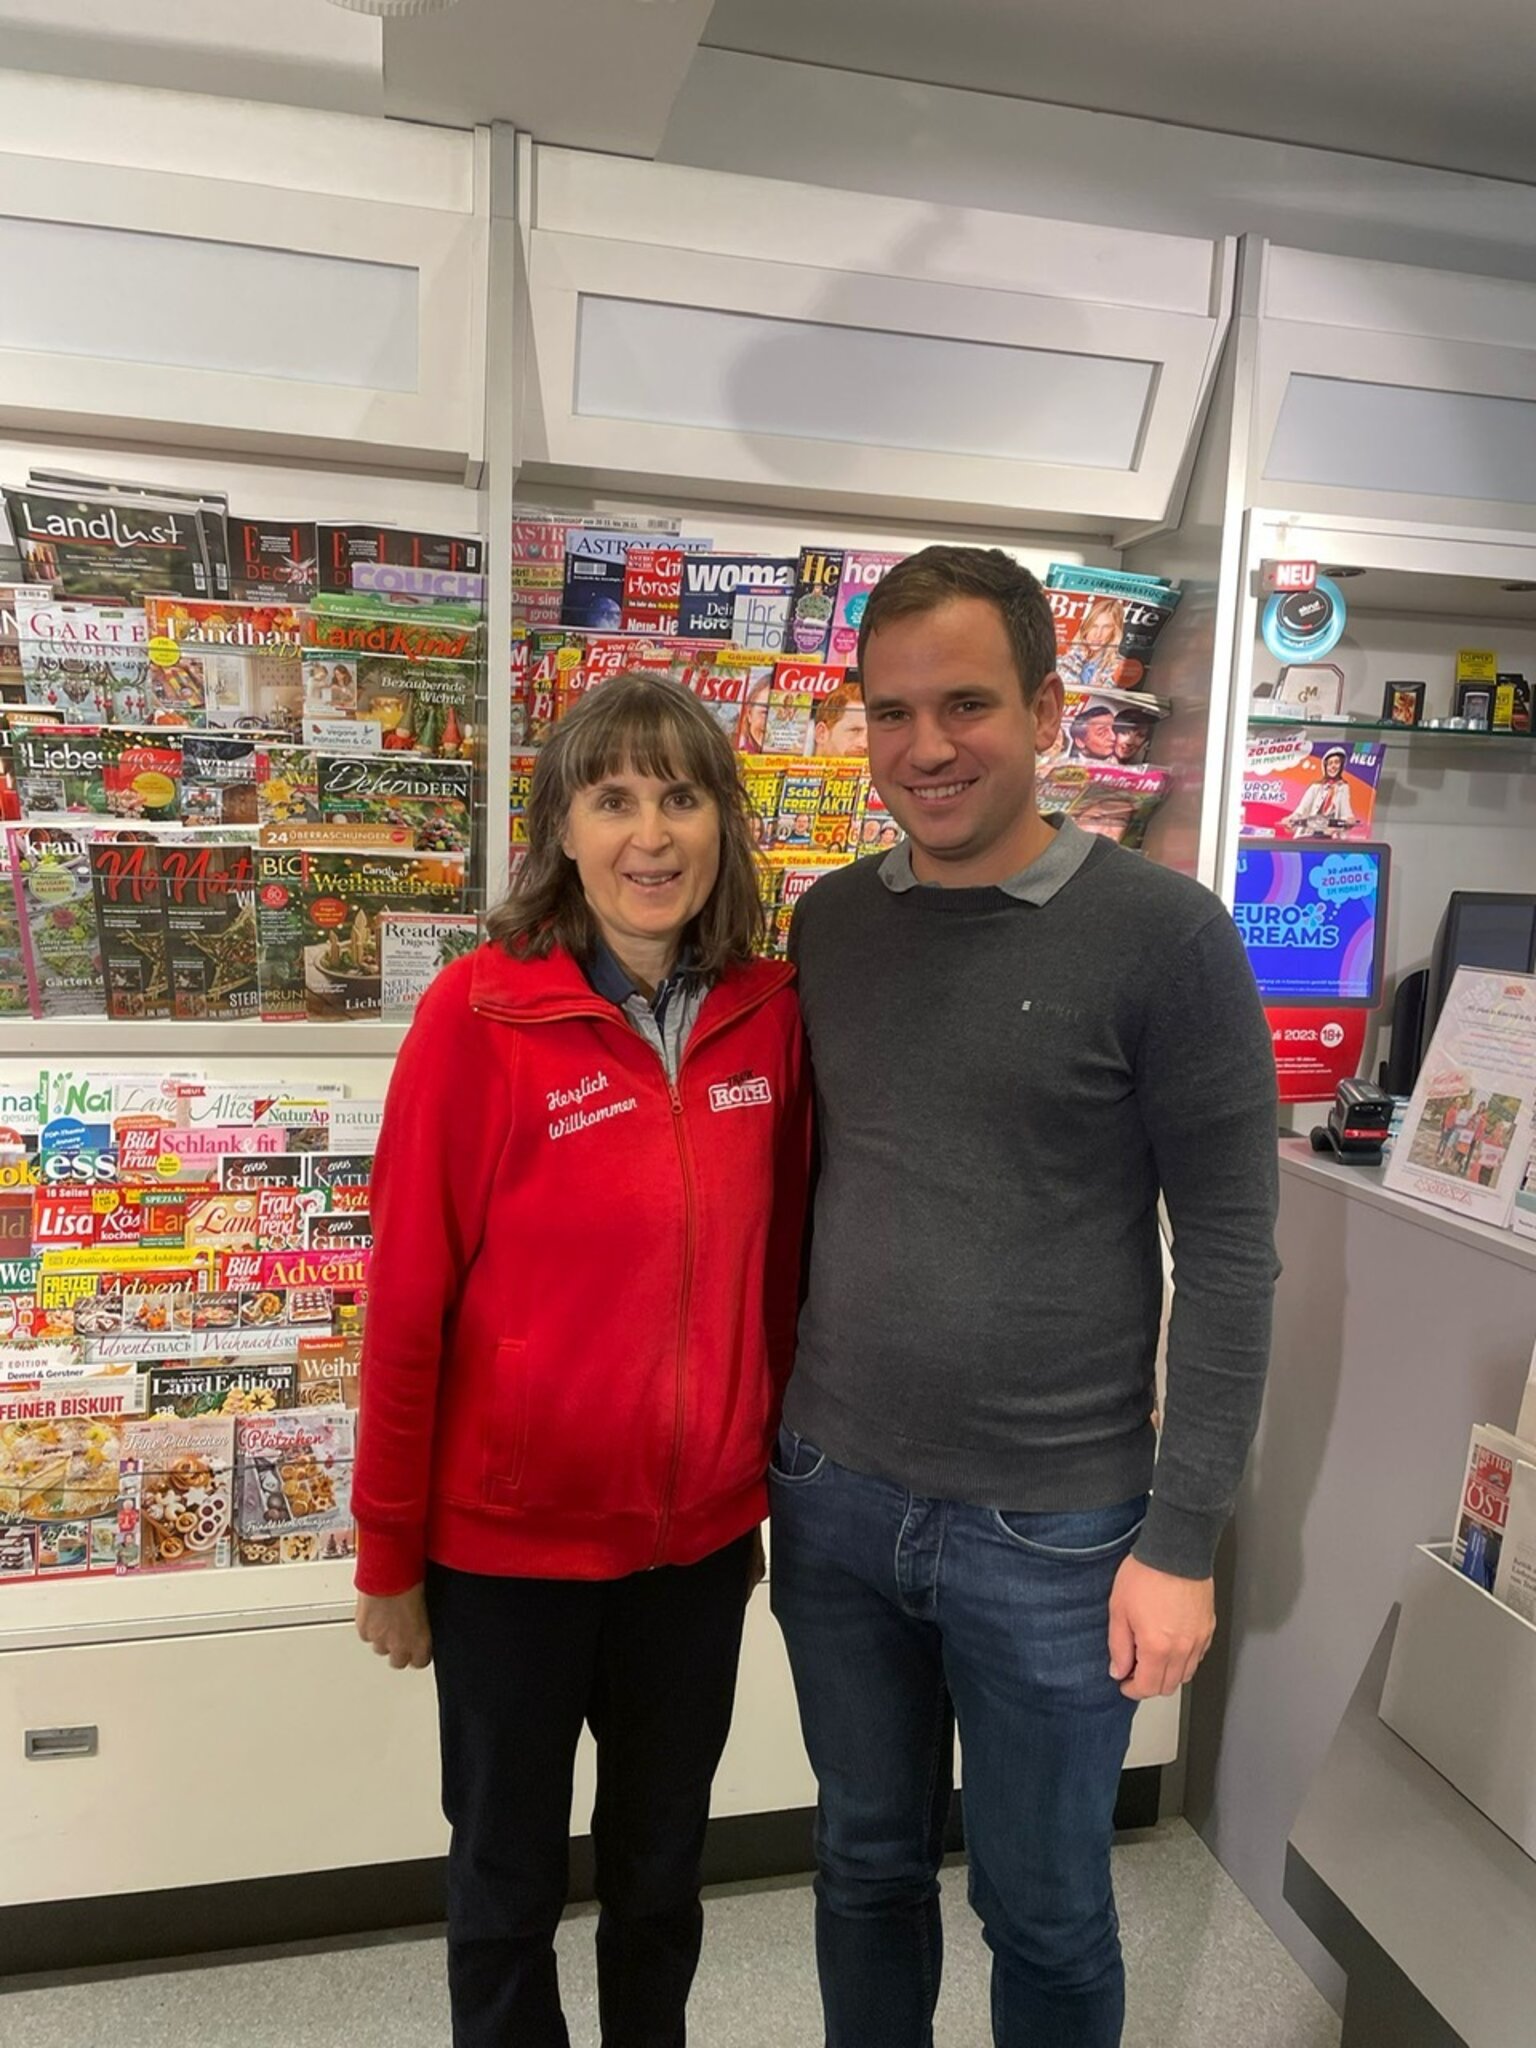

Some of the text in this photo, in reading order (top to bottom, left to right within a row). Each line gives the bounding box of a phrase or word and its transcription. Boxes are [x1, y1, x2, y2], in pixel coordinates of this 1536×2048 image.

[353, 563, 482, 598] COUCH
[801, 554, 840, 585] He
[1277, 564, 1316, 586] NEU
[778, 667, 840, 694] Gala
[1350, 752, 1377, 766] NEU
[267, 828, 391, 845] 24 ÜBERRASCHUNGEN
[313, 873, 456, 896] Weihnachten
[1234, 906, 1301, 925] EURO
[401, 938, 436, 949] Digest
[546, 1071, 609, 1111] Herzlich
[712, 1083, 768, 1107] ROTH
[548, 1097, 638, 1140] Willkommen
[125, 1130, 158, 1150] Bild
[121, 1152, 158, 1169] Frau
[259, 1191, 296, 1213] Frau
[39, 1205, 94, 1236] Lisa
[258, 1213, 295, 1236] Trend
[101, 1230, 140, 1241] kochen
[226, 1256, 262, 1277] Bild
[268, 1257, 365, 1286] Advent
[8, 1360, 48, 1370] EDITION
[46, 1369, 84, 1379] Gerstner
[0, 1396, 124, 1419] FEINER BISKUIT
